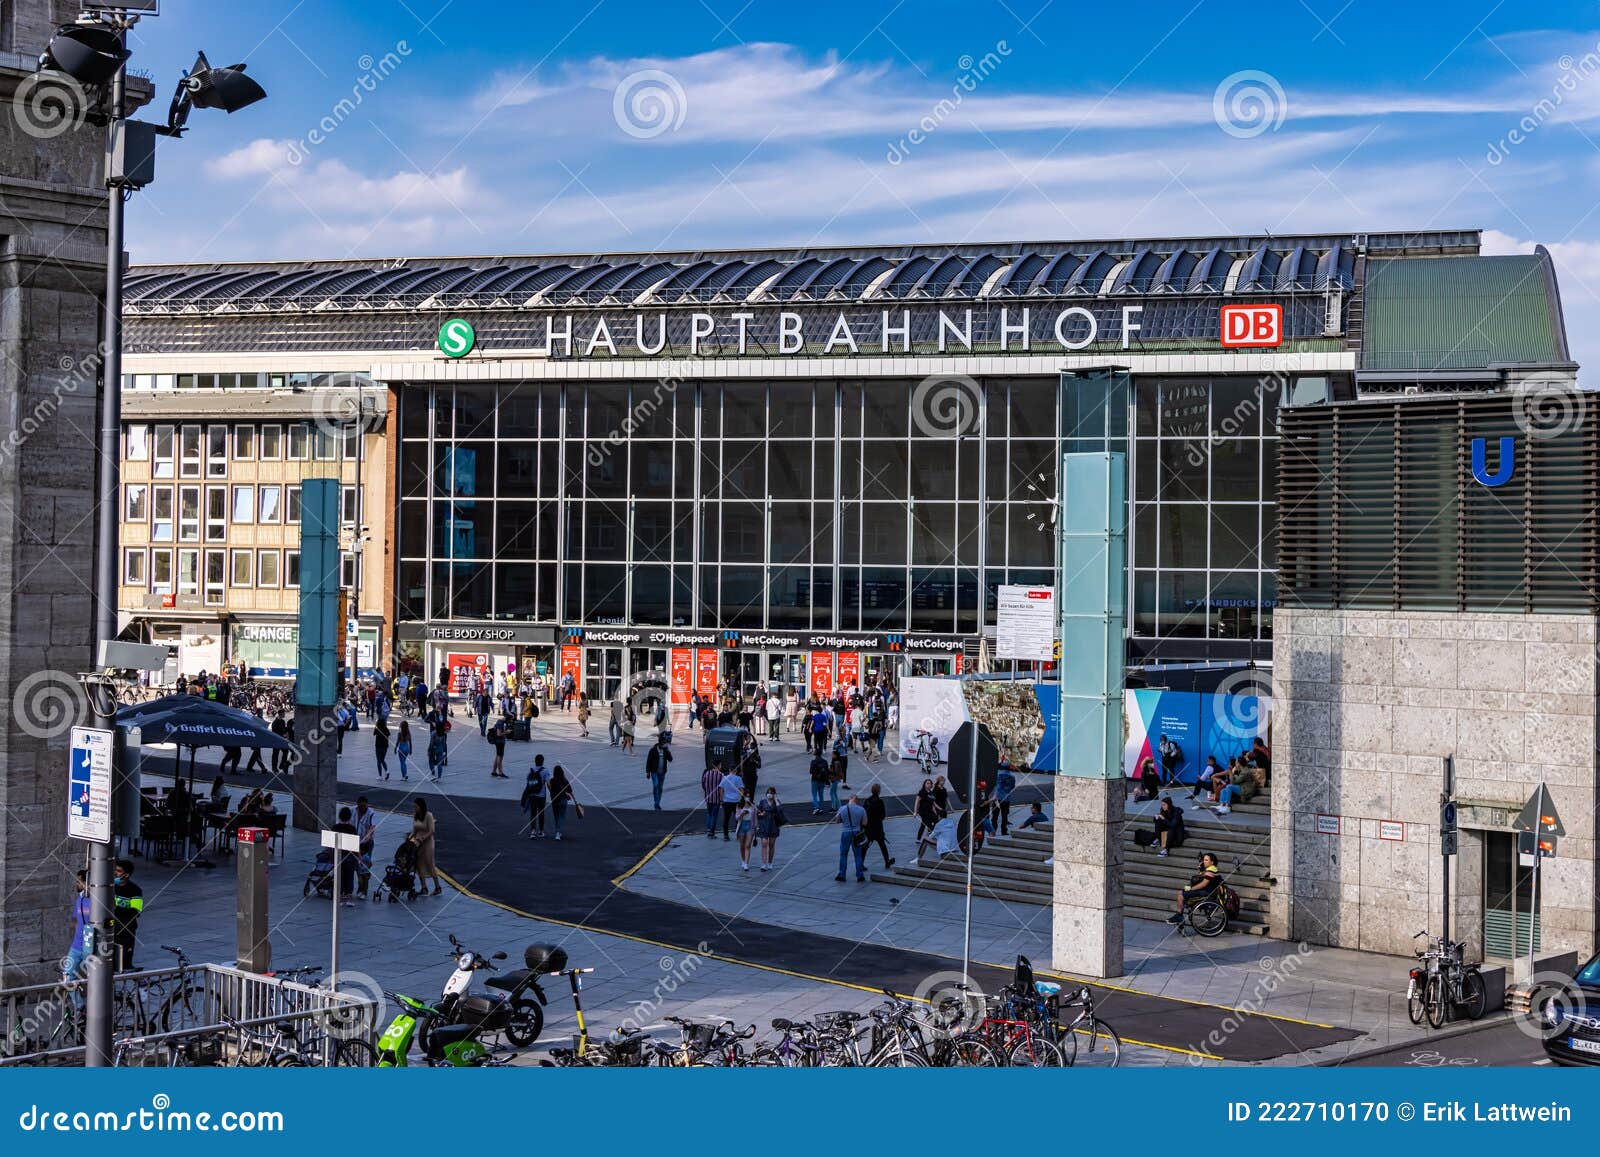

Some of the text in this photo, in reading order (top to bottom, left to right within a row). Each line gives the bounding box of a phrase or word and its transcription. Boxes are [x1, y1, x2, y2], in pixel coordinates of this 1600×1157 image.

[546, 305, 1143, 356] HAUPTBAHNHOF
[1227, 311, 1275, 340] DB
[444, 322, 468, 354] S
[1471, 436, 1515, 487] U
[243, 626, 292, 640] CHANGE
[431, 628, 515, 640] THE BODY SHOP
[585, 632, 640, 643] NetCologne
[665, 633, 716, 645] Highspeed
[742, 635, 799, 647] NetCologne
[827, 636, 878, 648] Highspeed
[462, 1048, 477, 1061] GO
